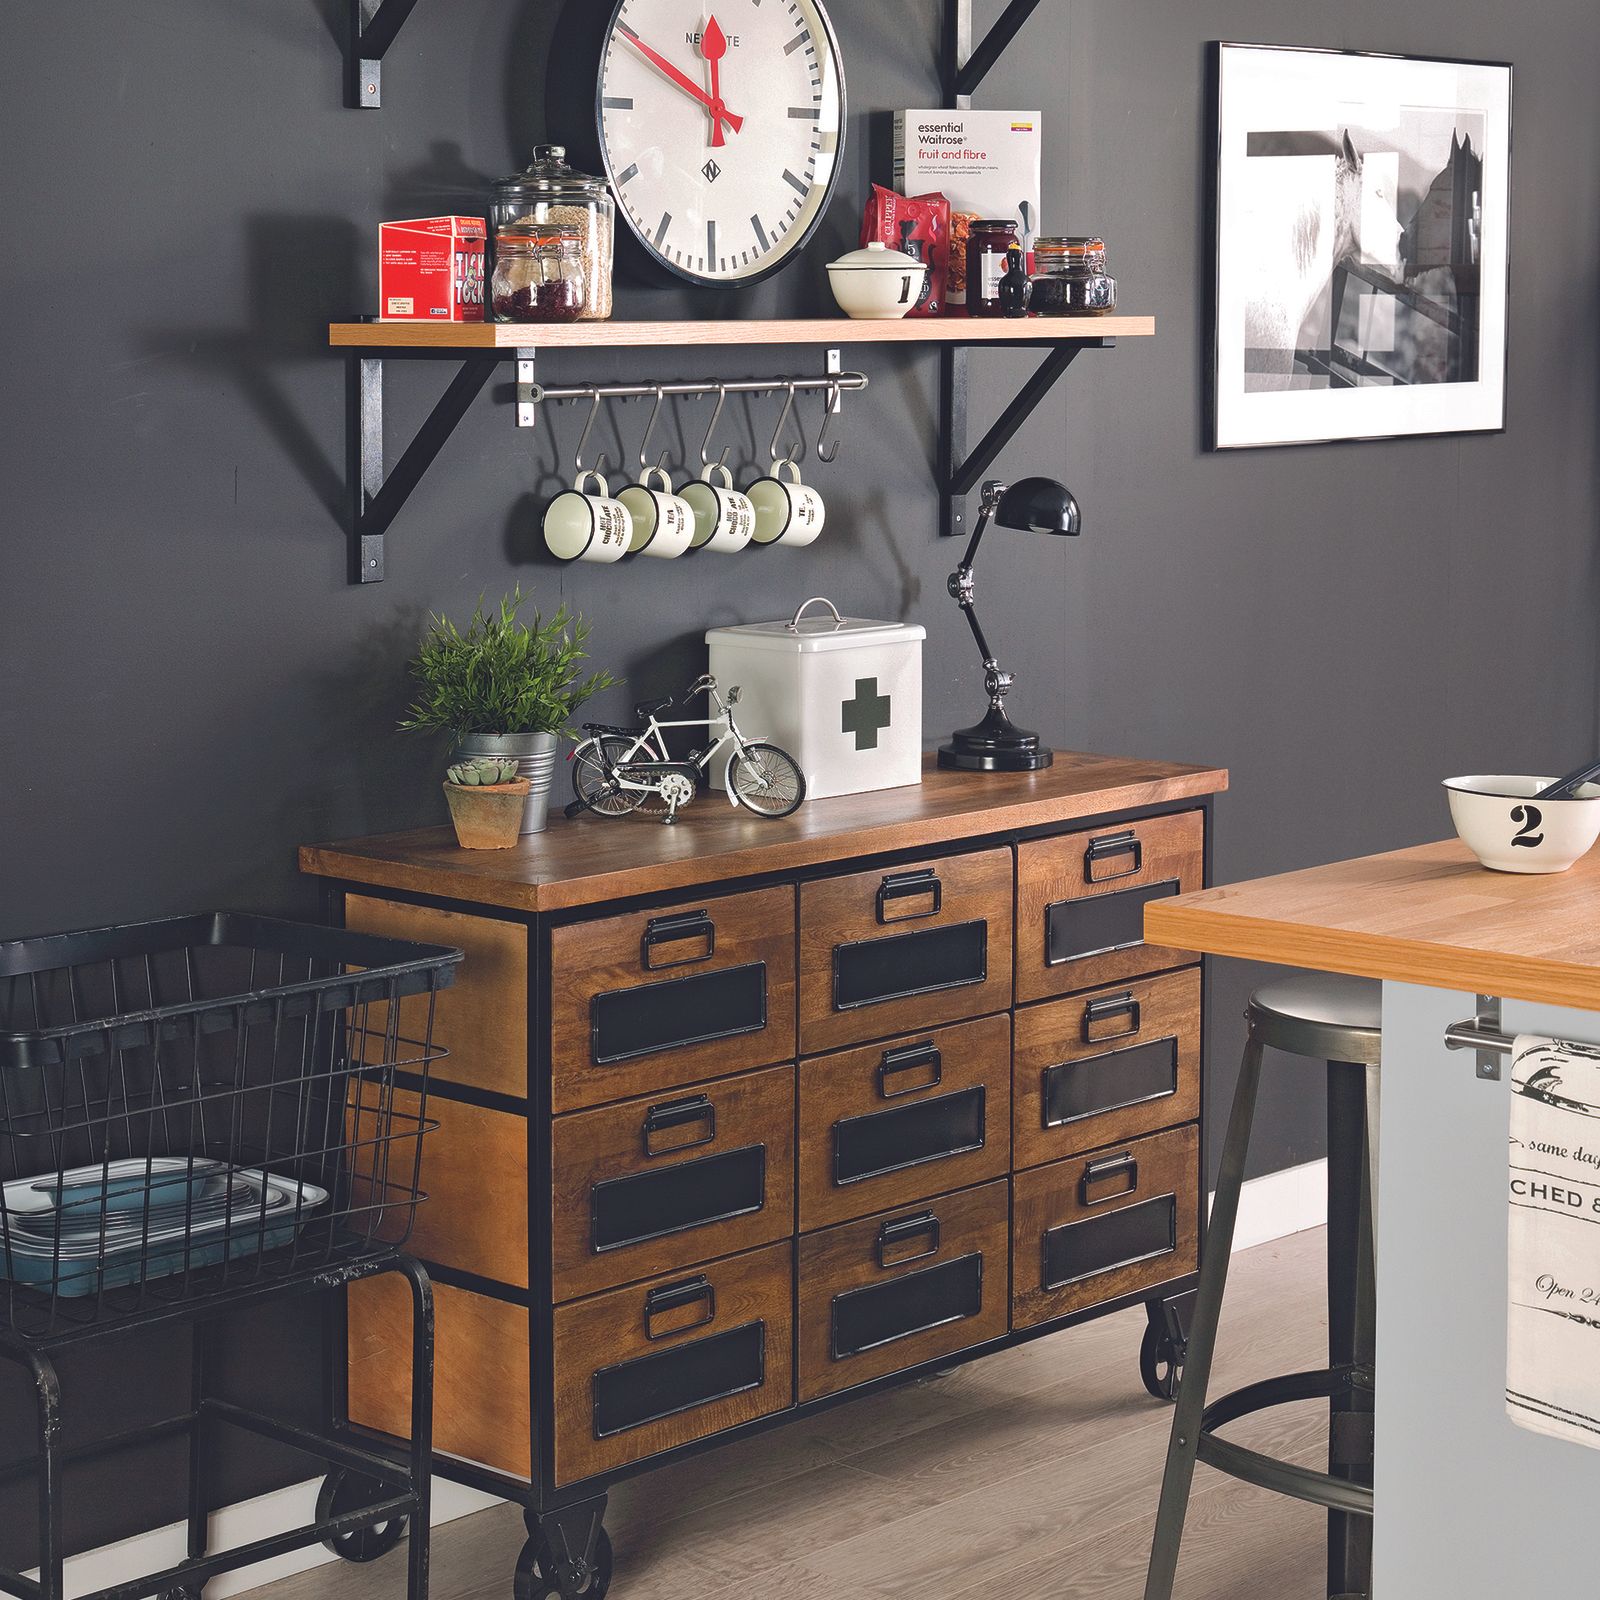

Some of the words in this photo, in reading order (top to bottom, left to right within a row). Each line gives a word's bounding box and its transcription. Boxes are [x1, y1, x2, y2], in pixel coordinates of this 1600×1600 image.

[685, 32, 740, 47] NETE
[918, 122, 963, 133] essential
[918, 134, 963, 145] Waitrose
[918, 149, 939, 160] fruit
[941, 149, 961, 160] and
[963, 149, 987, 160] fibre
[898, 275, 911, 304] 1
[602, 505, 613, 545] CHOCOLATE
[666, 509, 675, 525] TEA
[728, 496, 739, 535] CHOCOATE
[1509, 804, 1545, 848] 2
[1528, 1140, 1568, 1158] same
[1572, 1146, 1600, 1170] day
[1510, 1179, 1583, 1208] CHED
[1535, 1273, 1576, 1300] Open
